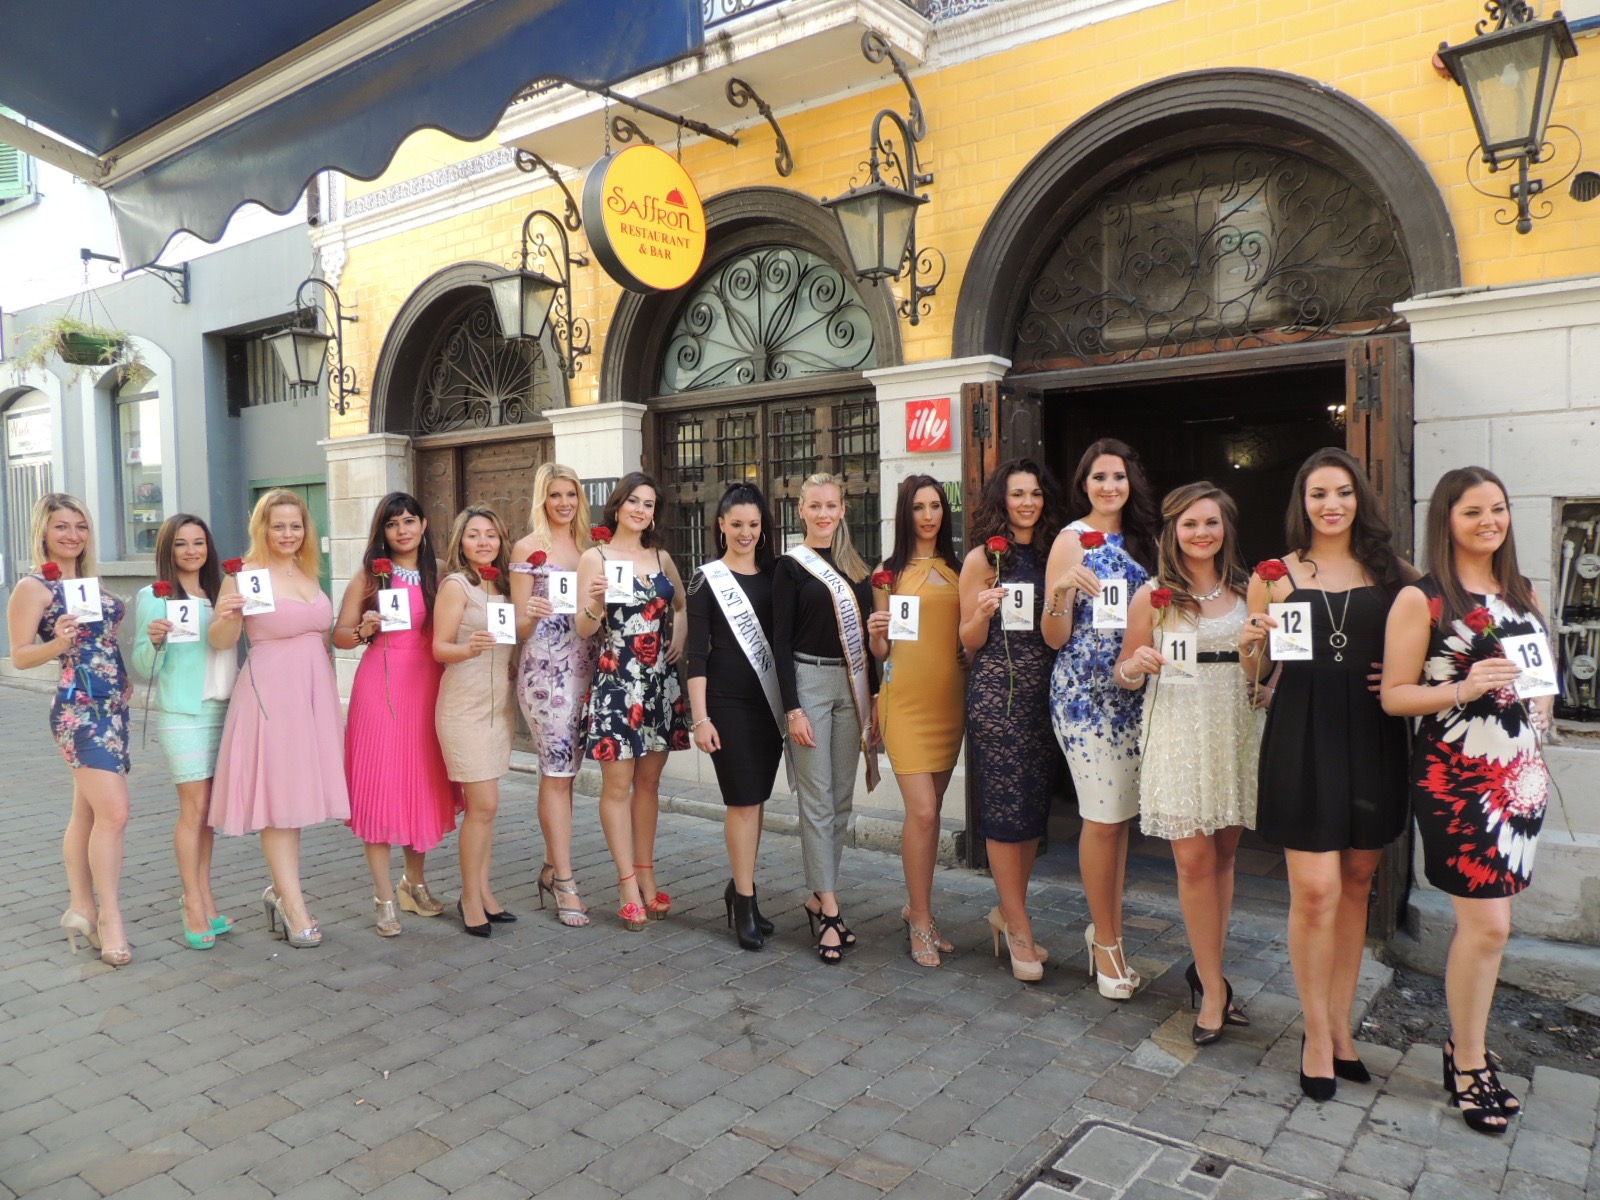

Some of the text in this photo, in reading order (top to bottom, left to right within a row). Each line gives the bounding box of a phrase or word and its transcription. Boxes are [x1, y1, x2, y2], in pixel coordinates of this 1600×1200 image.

[620, 222, 691, 249] RESTAURANT
[638, 243, 672, 260] & BAR
[908, 407, 948, 446] illy
[616, 566, 624, 584] 7
[78, 584, 87, 602] 1
[250, 576, 261, 594] 3
[560, 577, 568, 595] 6
[391, 594, 400, 611] 4
[1014, 589, 1023, 609] 9
[1102, 585, 1119, 606] 10
[179, 605, 189, 623] 2
[498, 608, 507, 625] 5
[900, 601, 910, 620] 8
[720, 587, 743, 608] 1ST
[733, 609, 772, 673] PRINCESS
[1281, 610, 1302, 634] 12
[839, 599, 863, 676] GIBRALTAR
[1171, 639, 1187, 661] 11
[1518, 642, 1543, 668] 13
